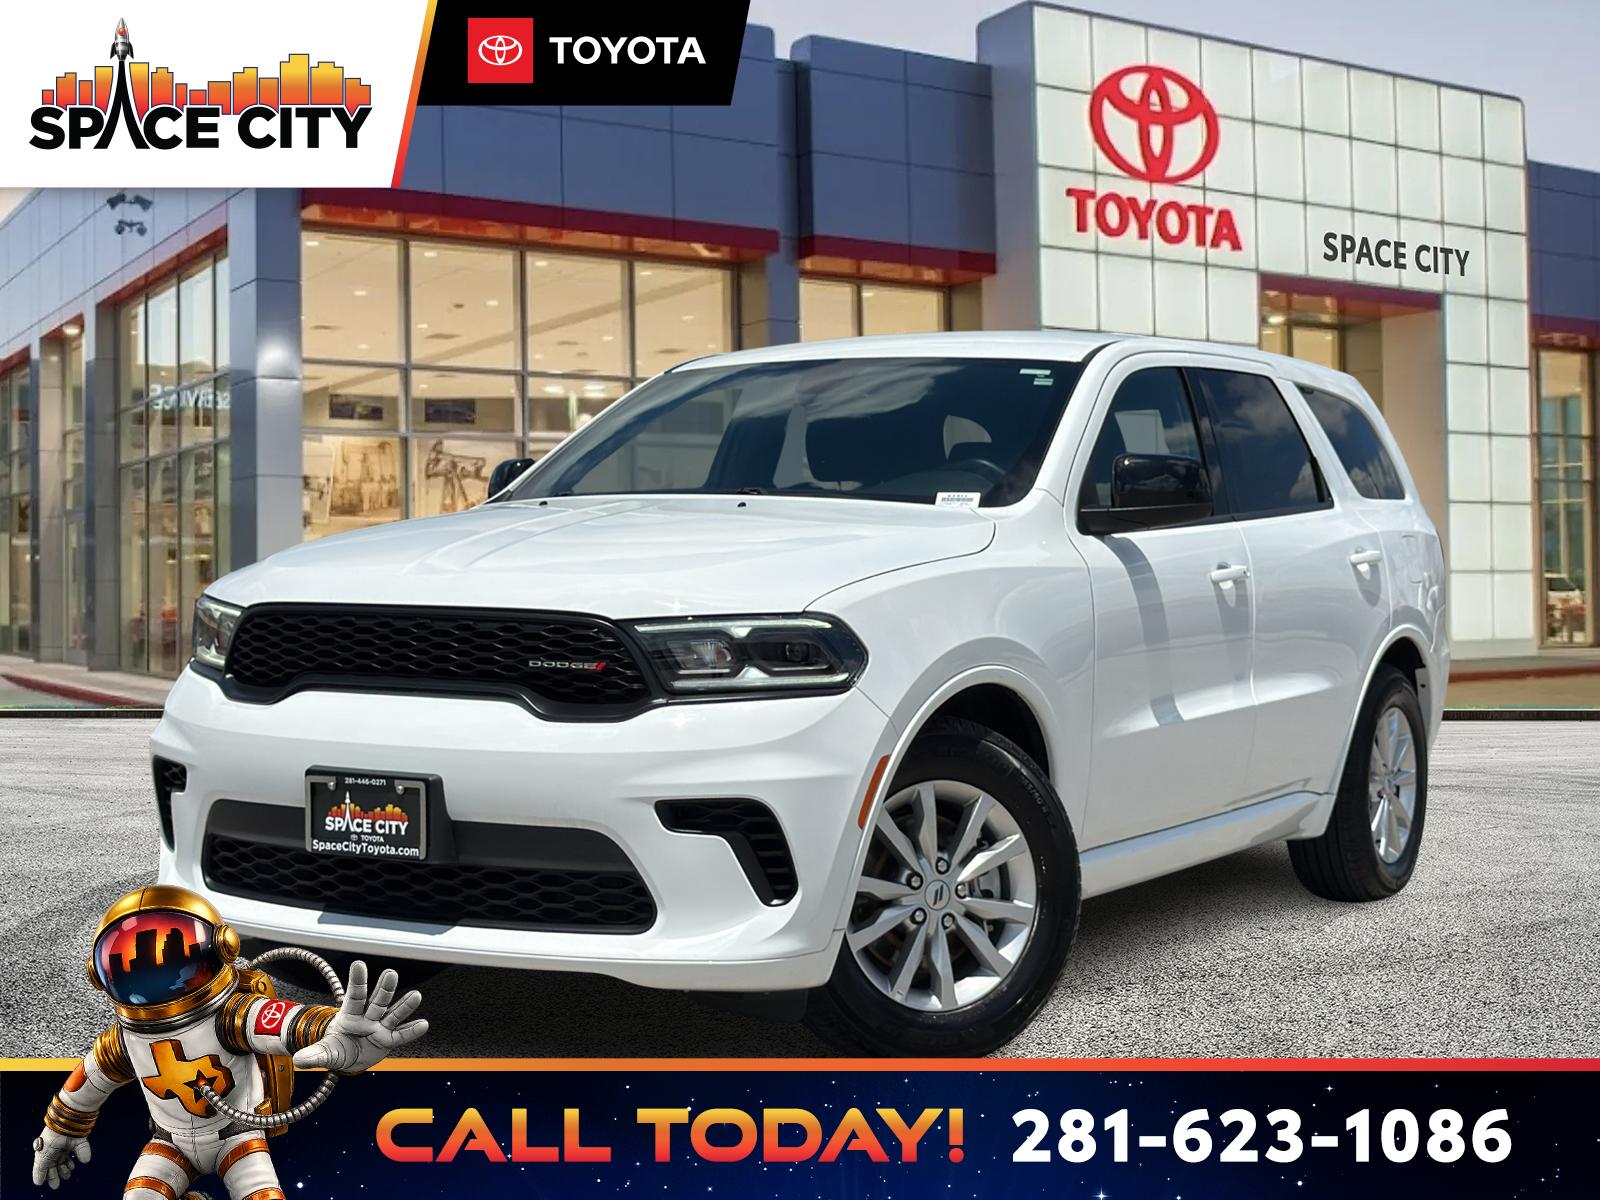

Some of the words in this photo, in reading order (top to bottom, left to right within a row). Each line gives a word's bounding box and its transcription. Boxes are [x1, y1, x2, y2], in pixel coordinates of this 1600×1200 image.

[1066, 187, 1242, 251] TOYOTA
[1323, 231, 1408, 270] SPACE
[1413, 244, 1471, 277] CITY
[528, 660, 598, 670] DODGE
[325, 816, 372, 832] SPACE
[375, 820, 408, 835] CITY
[312, 839, 419, 857] SpaceCityToyota.com
